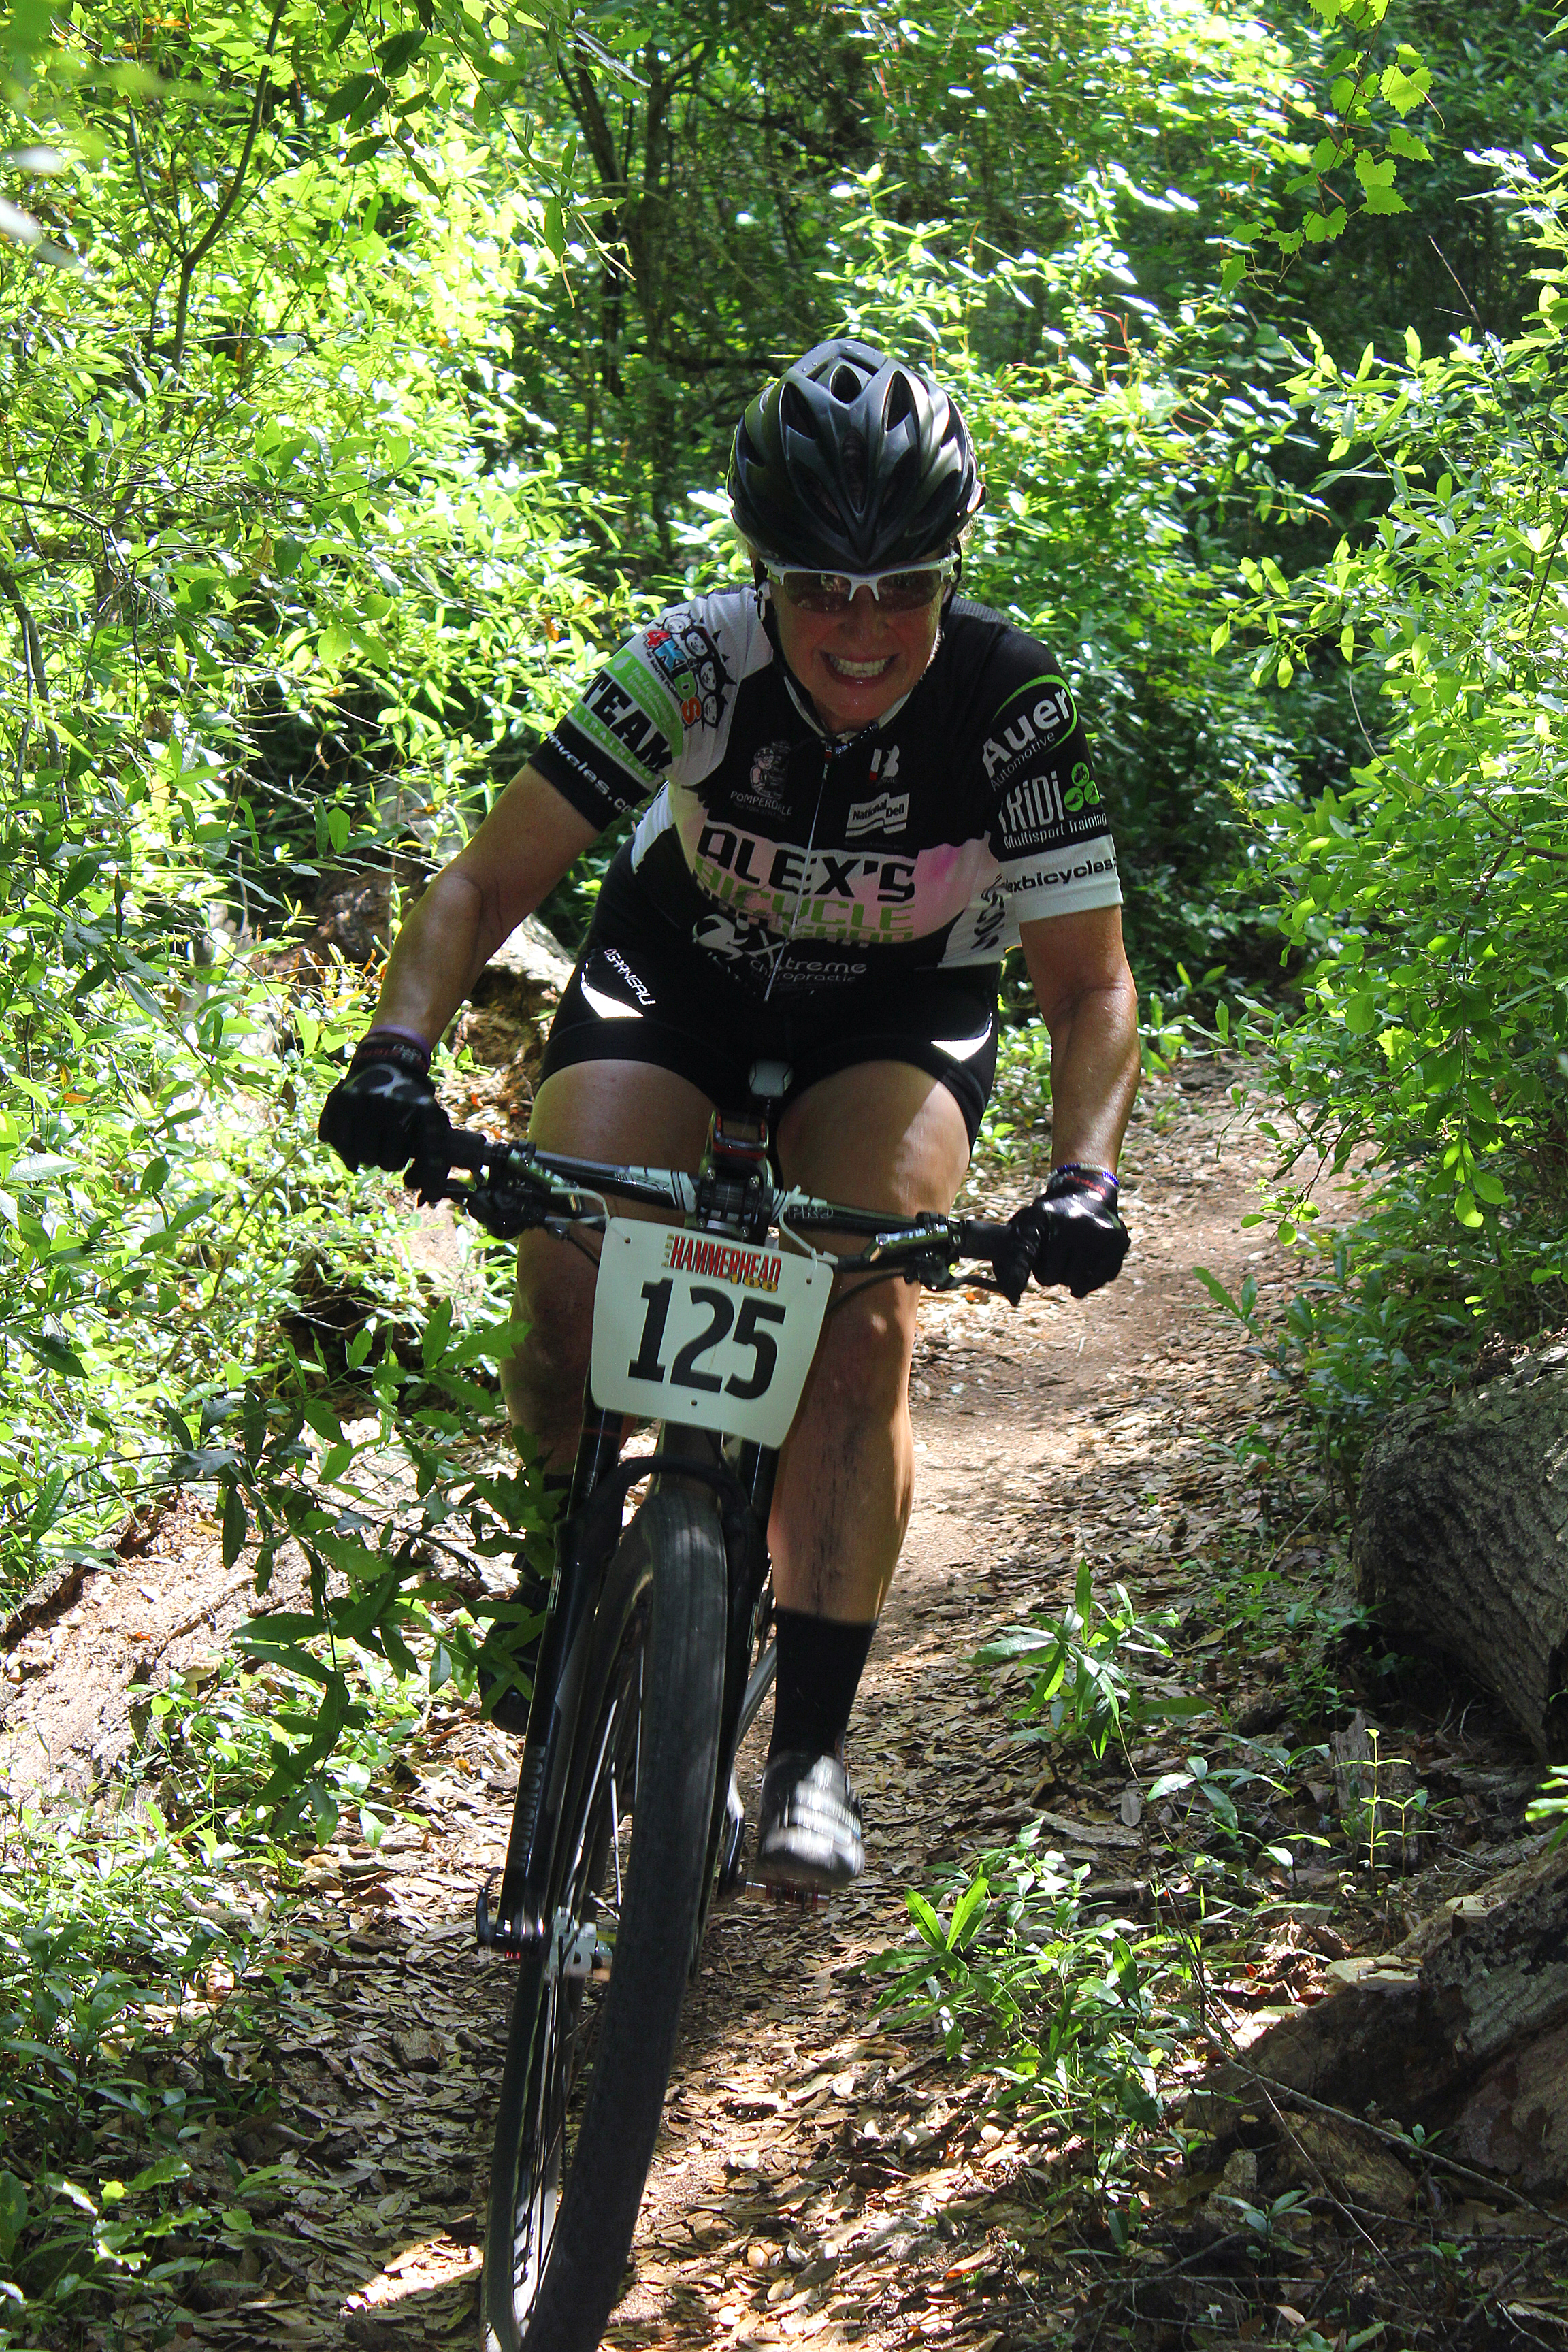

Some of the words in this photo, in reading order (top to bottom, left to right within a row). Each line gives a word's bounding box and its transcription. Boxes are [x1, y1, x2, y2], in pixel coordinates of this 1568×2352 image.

[581, 670, 673, 775] TEAM
[982, 688, 1070, 779] Auer
[990, 732, 1056, 792] Automotive
[730, 790, 793, 816] POMPERDALE
[852, 799, 887, 821] National
[885, 803, 904, 818] Dell
[1003, 823, 1065, 849] Multisport
[1068, 812, 1108, 834] Training
[696, 825, 915, 903] ALEX'S
[787, 1204, 834, 1220] PRO
[669, 1234, 782, 1285] HAMMERHEAD
[728, 1272, 778, 1293] 100
[627, 1276, 787, 1401] 125
